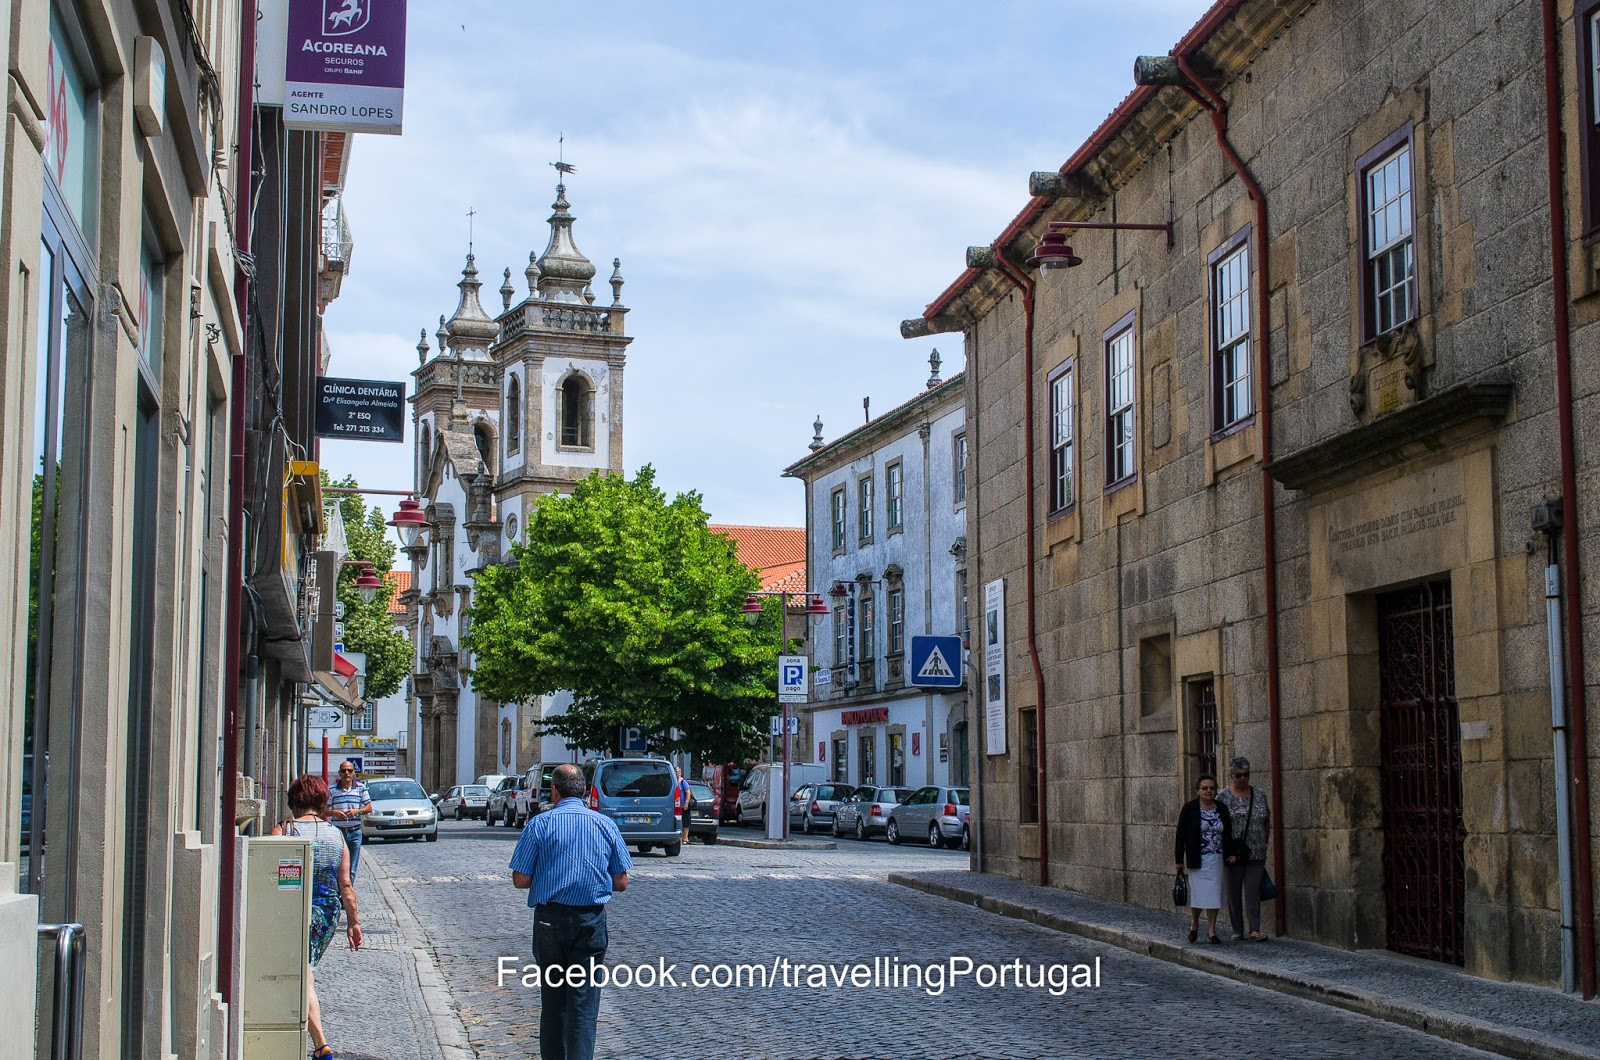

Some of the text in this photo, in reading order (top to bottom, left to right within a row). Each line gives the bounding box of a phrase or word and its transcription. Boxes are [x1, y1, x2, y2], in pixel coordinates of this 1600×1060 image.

[325, 57, 364, 66] SEGUROS
[291, 91, 324, 99] AGENTE
[291, 103, 394, 118] SANDRO LOPES
[324, 383, 398, 397] CLÍNICA DENTÁRIA
[336, 397, 369, 407] Elisangela
[371, 400, 398, 408] Almeida
[357, 412, 371, 420] ESQ
[346, 424, 356, 432] 271
[786, 667, 800, 684] P
[626, 727, 641, 749] P
